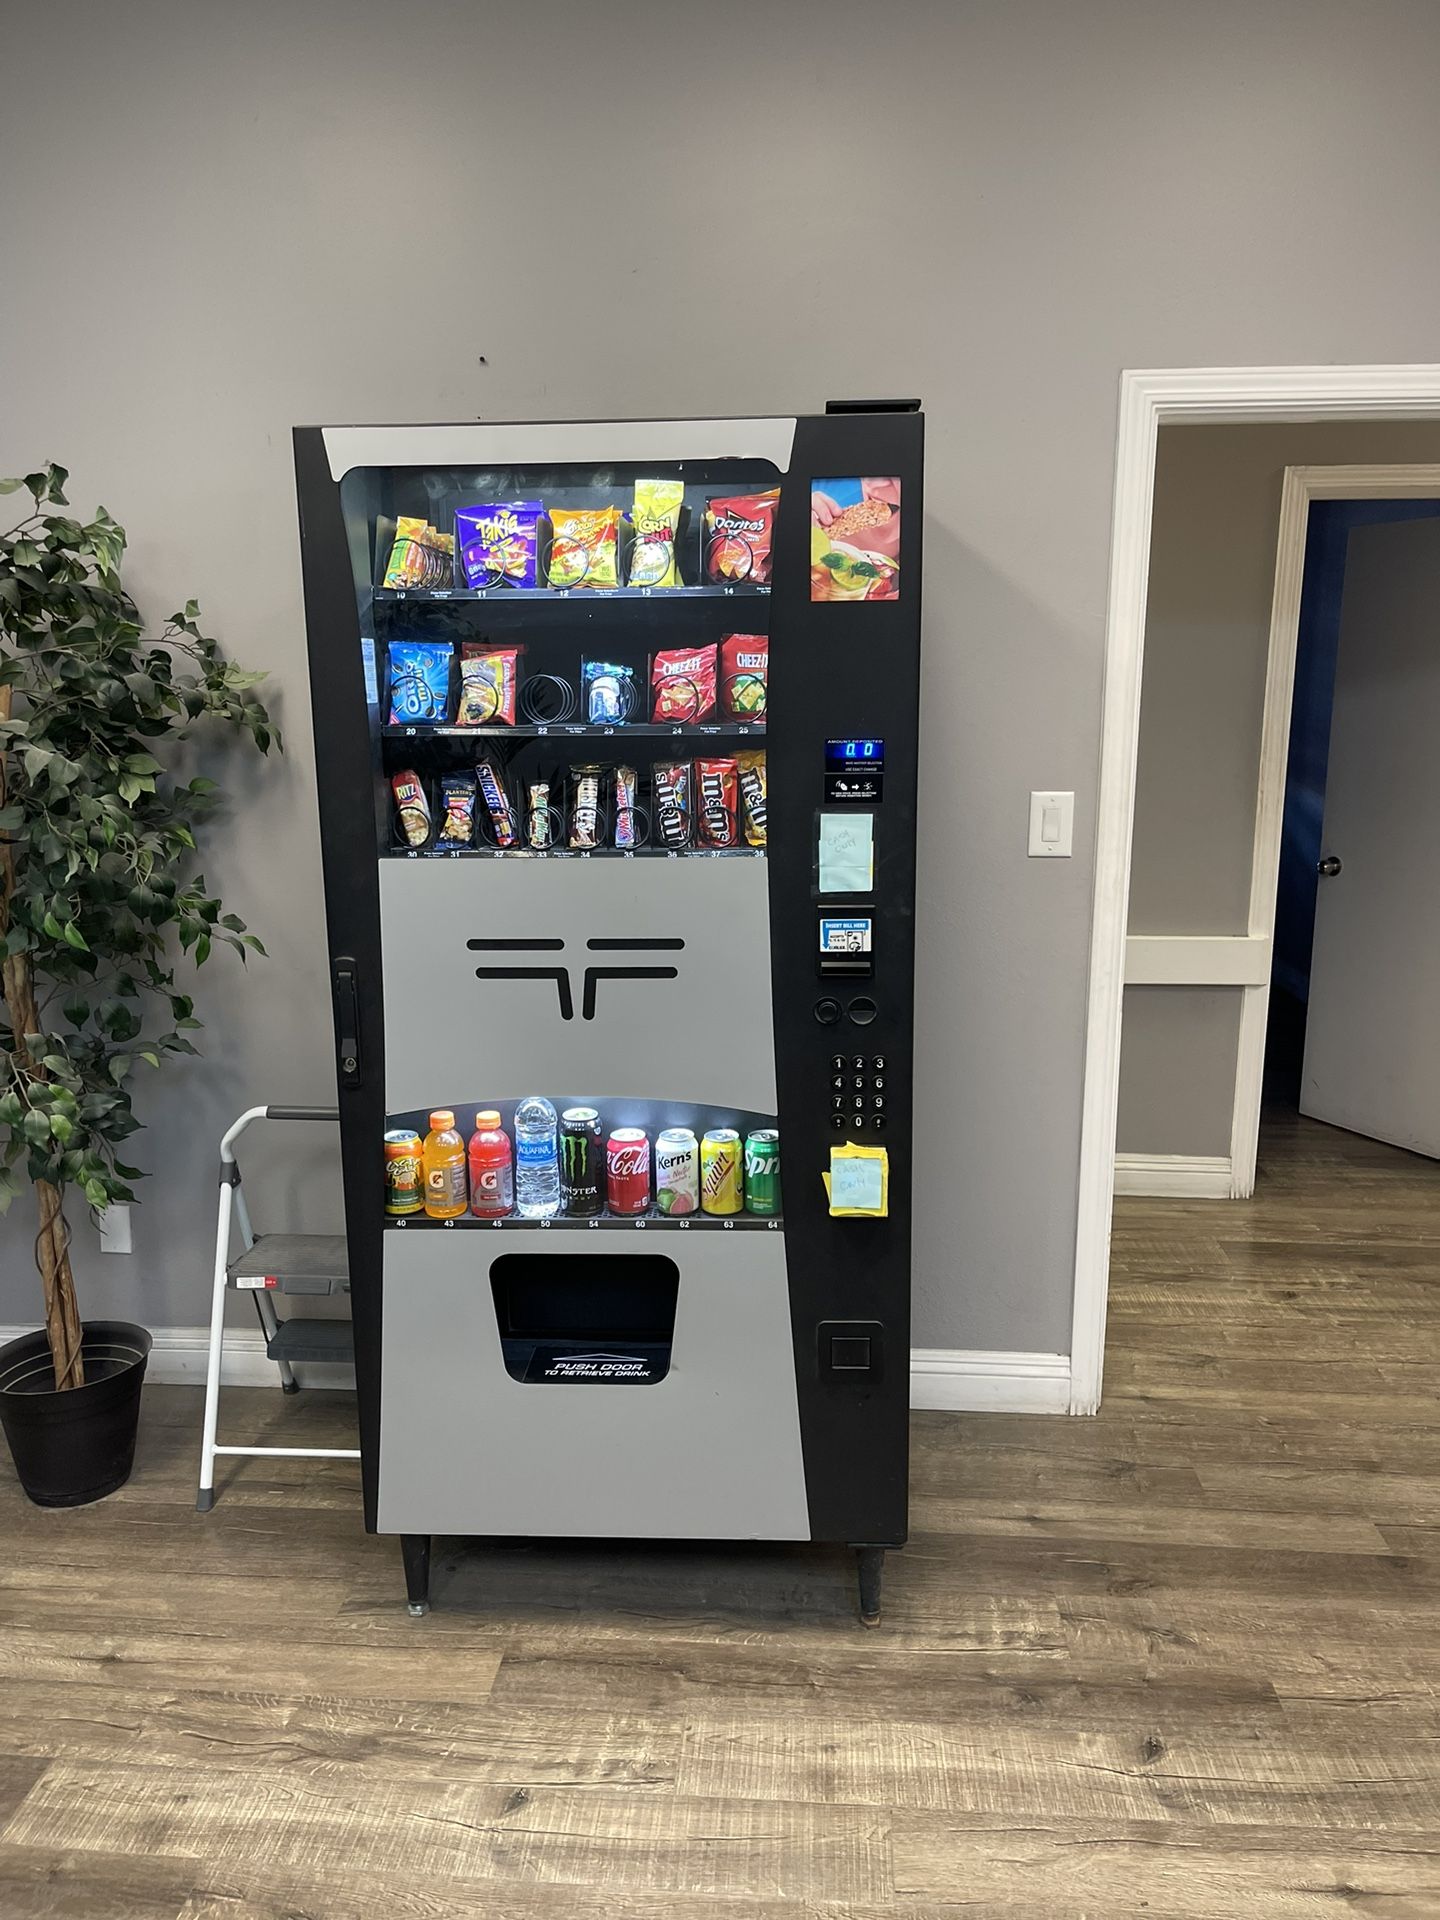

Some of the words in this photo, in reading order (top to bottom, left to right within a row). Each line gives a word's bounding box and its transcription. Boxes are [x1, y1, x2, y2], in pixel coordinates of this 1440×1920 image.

[715, 516, 765, 531] Doritos
[406, 727, 417, 735] 20
[472, 727, 481, 735] 21
[537, 727, 548, 735] 22
[604, 727, 614, 735] 23
[672, 727, 682, 735] 24
[738, 726, 749, 734] 25
[396, 783, 416, 800] RITZ
[711, 850, 721, 858] 37
[754, 850, 765, 858] 38
[835, 1058, 842, 1068] 1
[855, 1058, 862, 1068] 2
[876, 1058, 883, 1068] 3
[834, 1078, 842, 1088] 4
[855, 1078, 862, 1088] 5
[876, 1078, 883, 1088] 6
[834, 1098, 841, 1108] 7
[855, 1098, 862, 1108] 8
[875, 1098, 882, 1108] 9
[855, 1117, 862, 1127] 0
[518, 1145, 551, 1155] AQUAFINA
[429, 1170, 444, 1189] G
[480, 1171, 497, 1190] G
[396, 1219, 406, 1227] 40
[589, 1220, 599, 1228] 54
[635, 1220, 646, 1228] 60
[767, 1221, 778, 1229] 64
[599, 1363, 644, 1371] DOOR
